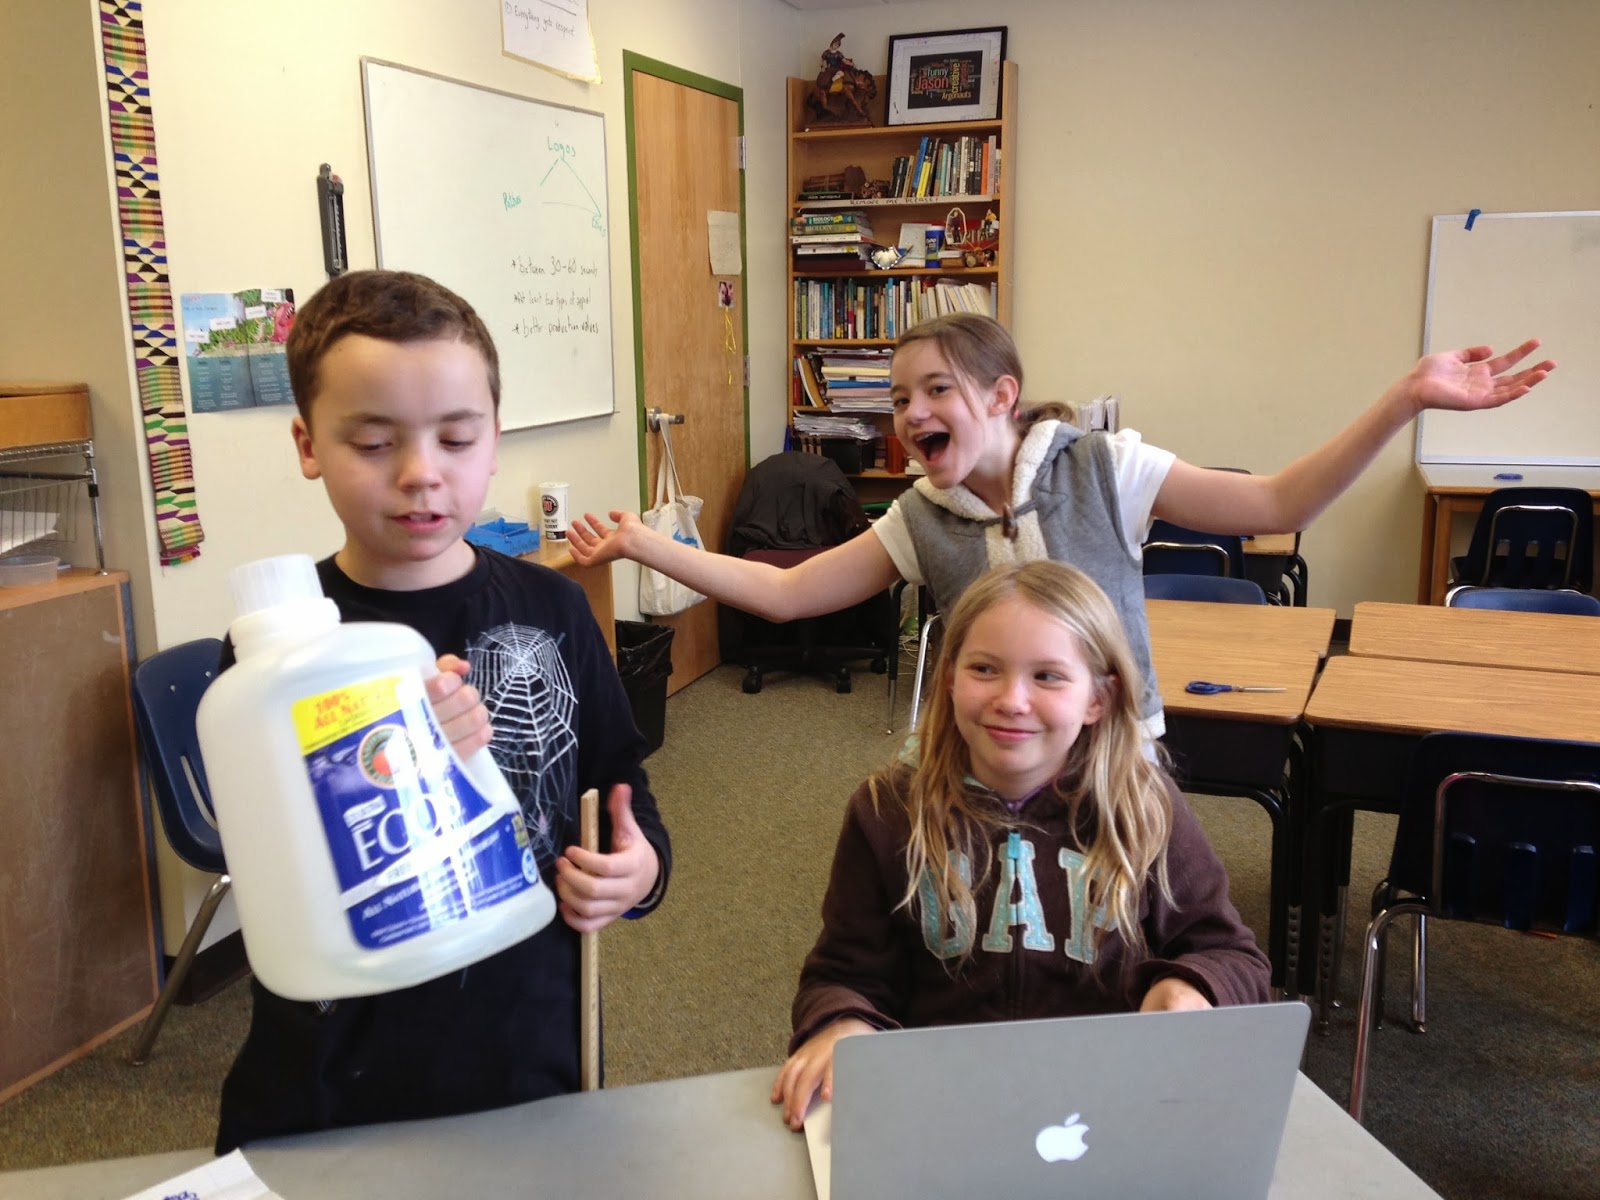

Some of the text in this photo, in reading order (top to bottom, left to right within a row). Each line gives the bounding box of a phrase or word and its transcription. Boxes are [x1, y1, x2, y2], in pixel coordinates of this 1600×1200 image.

[927, 66, 949, 77] funny
[951, 62, 961, 94] creative
[915, 77, 949, 91] Jason
[546, 136, 576, 160] Logos
